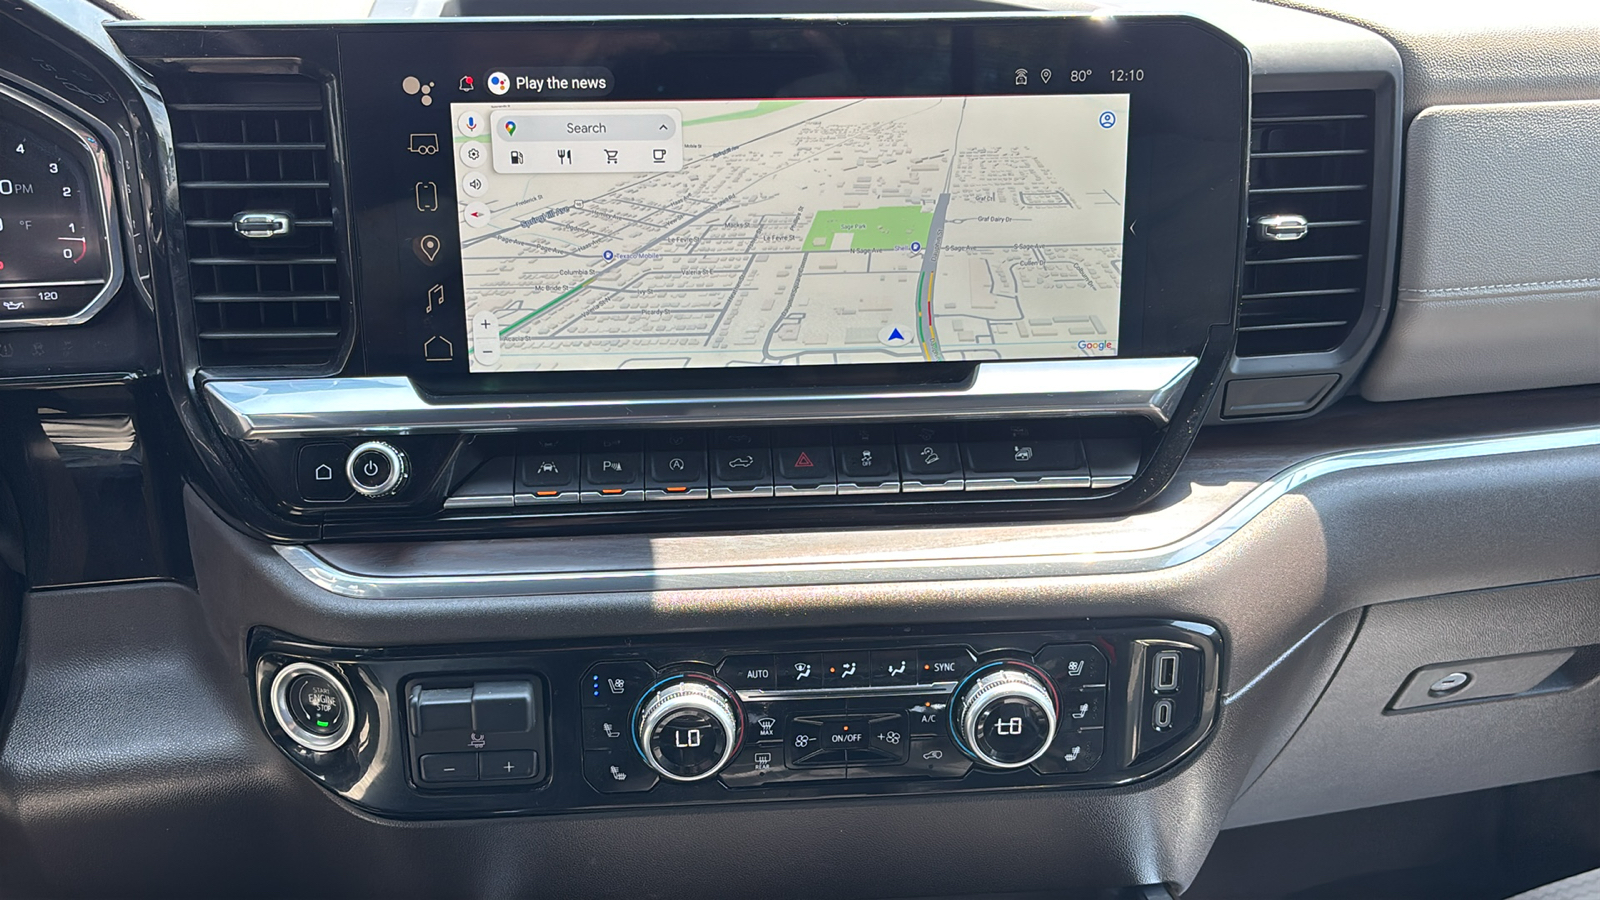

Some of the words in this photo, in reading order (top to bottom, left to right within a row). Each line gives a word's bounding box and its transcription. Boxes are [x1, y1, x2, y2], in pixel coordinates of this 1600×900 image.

[1070, 69, 1093, 82] 80°
[1110, 69, 1144, 82] 12:10
[516, 76, 544, 92] Play
[547, 76, 568, 89] the
[572, 79, 606, 89] news
[567, 123, 606, 133] Search
[16, 144, 25, 154] 4
[49, 163, 58, 173] 3
[62, 187, 71, 196] 2
[516, 197, 536, 206] Frederick
[554, 205, 570, 216] Ave
[68, 223, 75, 233] 1
[497, 236, 511, 244] Page
[536, 244, 550, 252] Page
[856, 248, 871, 256] Sage
[931, 236, 942, 261] Dauphin
[63, 249, 72, 258] 0
[1073, 262, 1089, 281] Colburn
[38, 292, 58, 300] 120
[581, 304, 600, 318] Valeria
[1078, 340, 1112, 351] Google
[603, 461, 611, 471] P
[934, 663, 955, 672] SYNC
[747, 670, 769, 678] AUTO
[308, 694, 336, 706] ENGINE
[921, 714, 936, 723] A/C
[832, 734, 862, 742] ON/OFF
